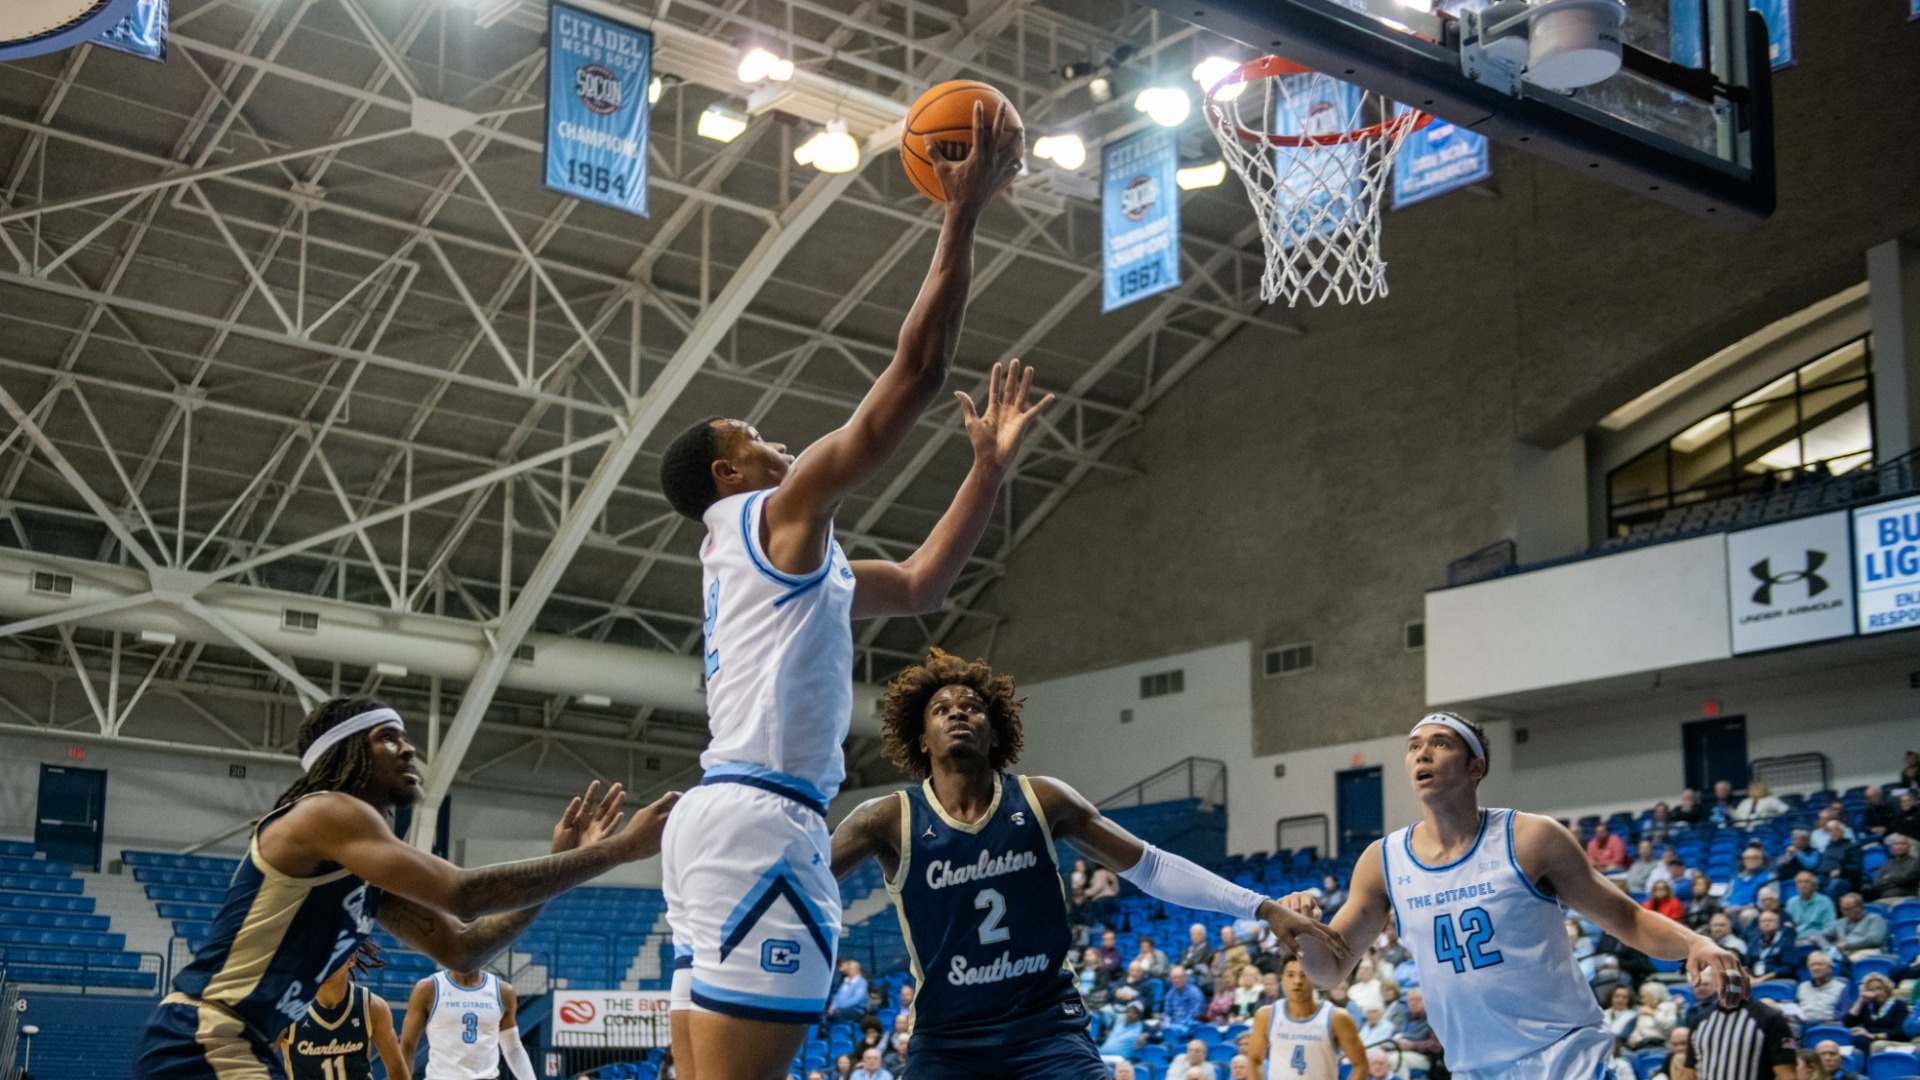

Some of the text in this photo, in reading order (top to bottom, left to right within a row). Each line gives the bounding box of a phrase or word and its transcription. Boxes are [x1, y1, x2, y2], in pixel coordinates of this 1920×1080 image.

[558, 14, 643, 59] CITADEL
[576, 68, 623, 107] SOCON
[567, 158, 626, 199] 1964
[1119, 260, 1161, 297] 1967
[1739, 599, 1843, 625] UNDER ARMOUR
[926, 849, 1037, 890] Charleston
[1406, 882, 1496, 909] THE CITADEL
[974, 888, 1010, 945] 2
[1433, 906, 1504, 974] 42
[948, 951, 1050, 986] Southern
[604, 999, 634, 1011] THE
[462, 1013, 478, 1044] 3
[297, 1038, 364, 1056] Charleston
[1290, 1045, 1306, 1075] 4
[321, 1055, 347, 1080] 11
